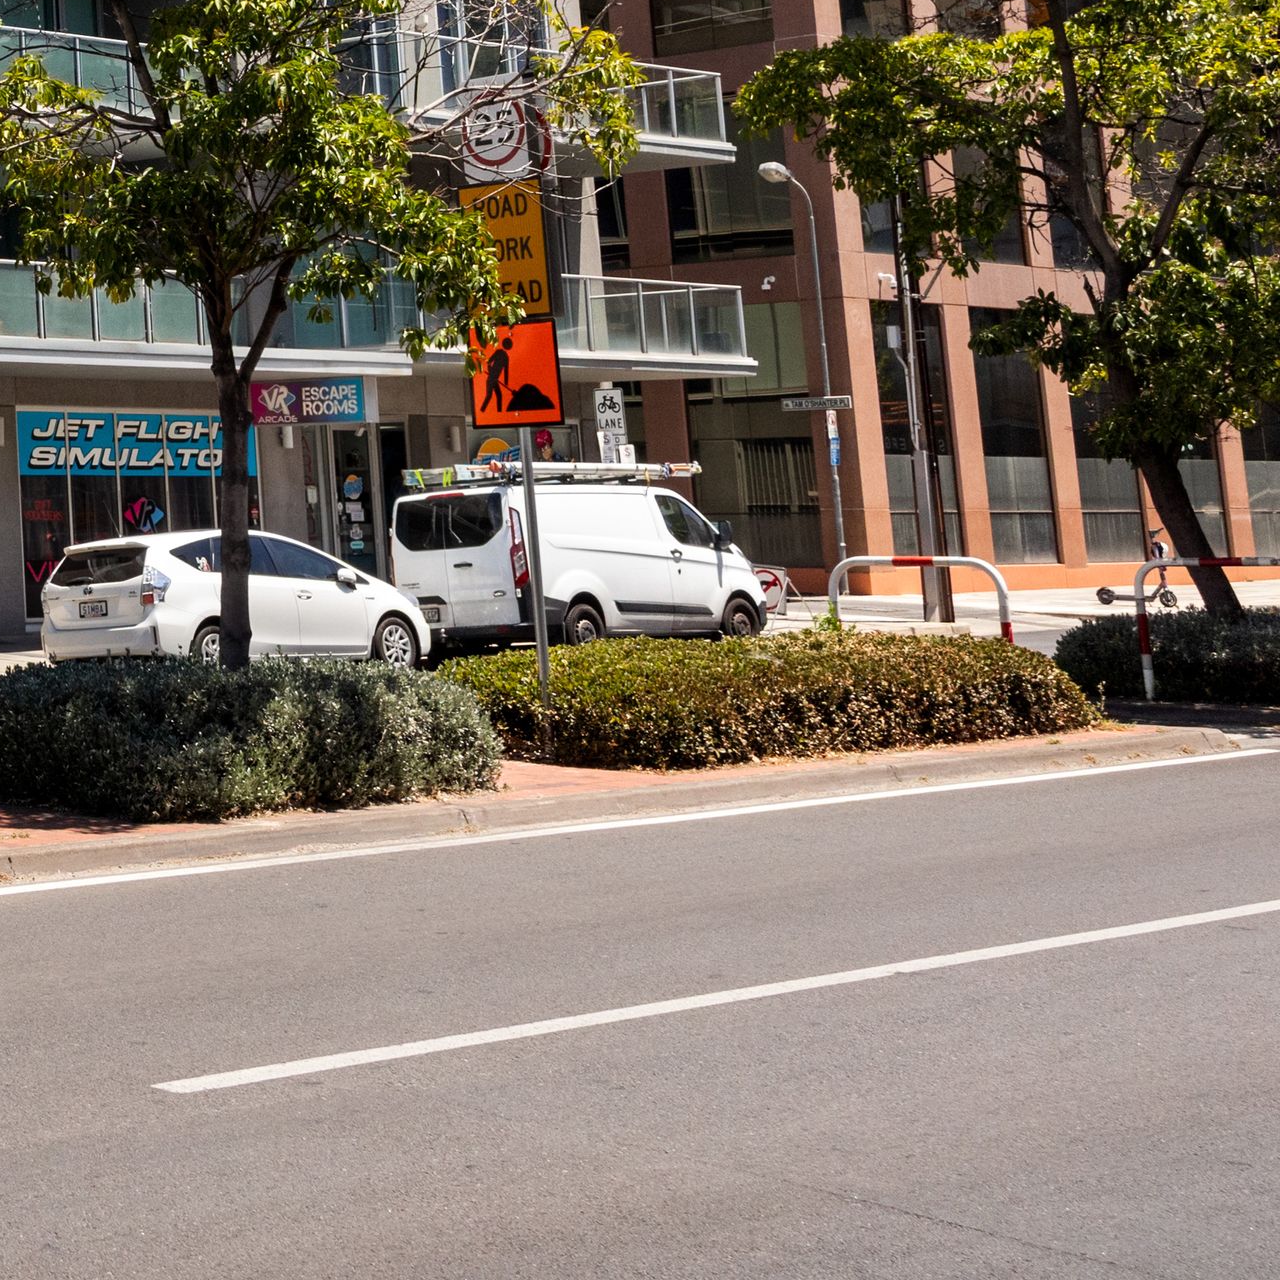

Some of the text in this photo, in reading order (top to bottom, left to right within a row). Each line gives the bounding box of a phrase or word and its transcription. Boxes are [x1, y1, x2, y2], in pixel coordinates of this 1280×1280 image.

[475, 110, 514, 146] 25
[487, 236, 533, 263] ORK
[261, 385, 290, 415] VR
[302, 385, 357, 401] ESCAPE
[303, 400, 358, 416] ROOMS
[31, 418, 223, 441] JET FLIGH
[258, 415, 298, 424] ARCADE
[599, 418, 623, 429] LANE
[29, 446, 223, 468] SIMULATO
[26, 561, 56, 583] VI
